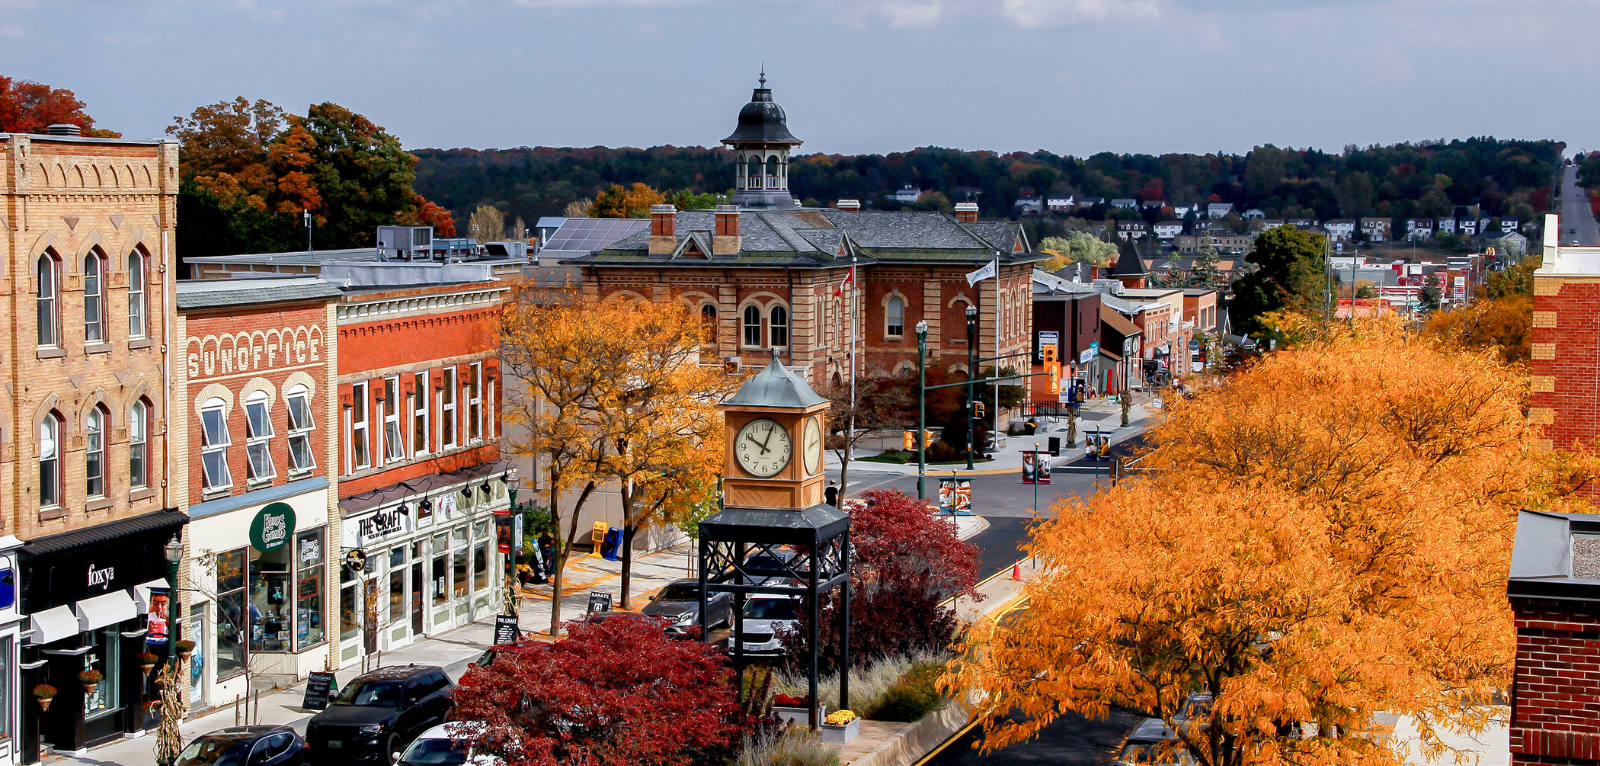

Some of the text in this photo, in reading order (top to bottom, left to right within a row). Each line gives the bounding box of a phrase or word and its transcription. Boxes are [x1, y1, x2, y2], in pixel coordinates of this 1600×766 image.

[238, 339, 320, 371] OFFICE
[752, 425, 759, 433] 11
[762, 422, 772, 431] 12
[745, 432, 753, 440] 10
[780, 433, 786, 441] 2
[740, 443, 747, 451] 9
[783, 445, 790, 453] 3
[744, 454, 750, 462] 8
[779, 455, 785, 463] 4
[753, 462, 759, 470] 7
[762, 465, 768, 473] 6
[772, 462, 778, 470] 5
[359, 517, 374, 537] THE
[87, 563, 111, 590] foxy
